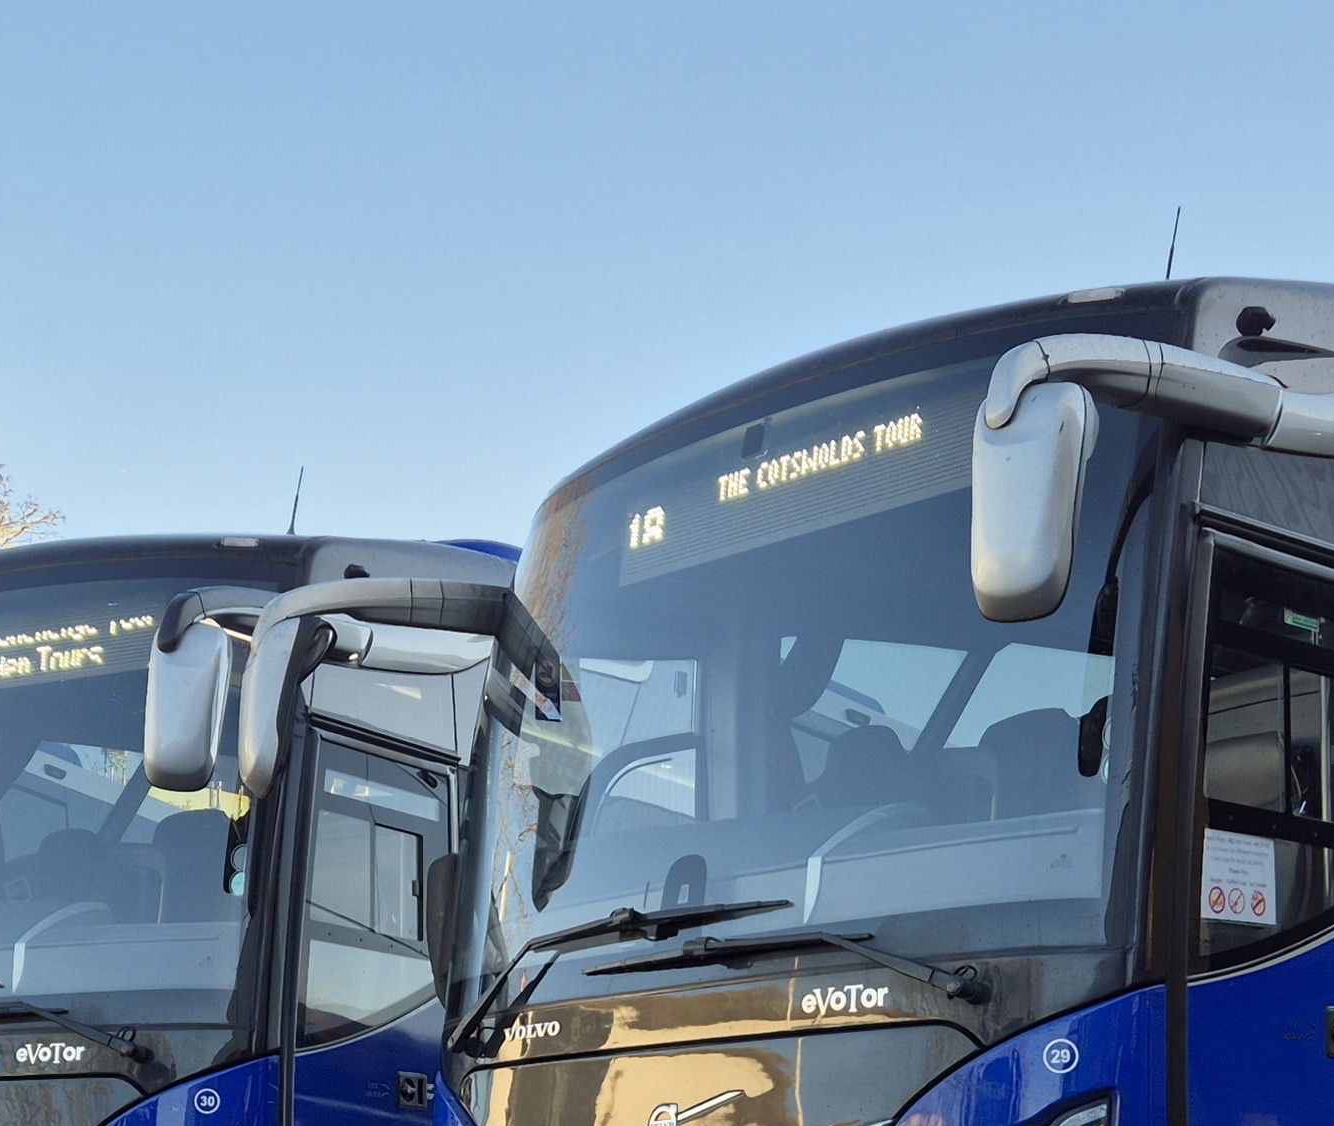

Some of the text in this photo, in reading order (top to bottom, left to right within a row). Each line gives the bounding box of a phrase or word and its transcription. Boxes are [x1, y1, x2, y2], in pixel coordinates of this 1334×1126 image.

[503, 1020, 561, 1042] VOLVO
[1050, 1048, 1071, 1064] 29
[200, 1095, 215, 1107] 30
